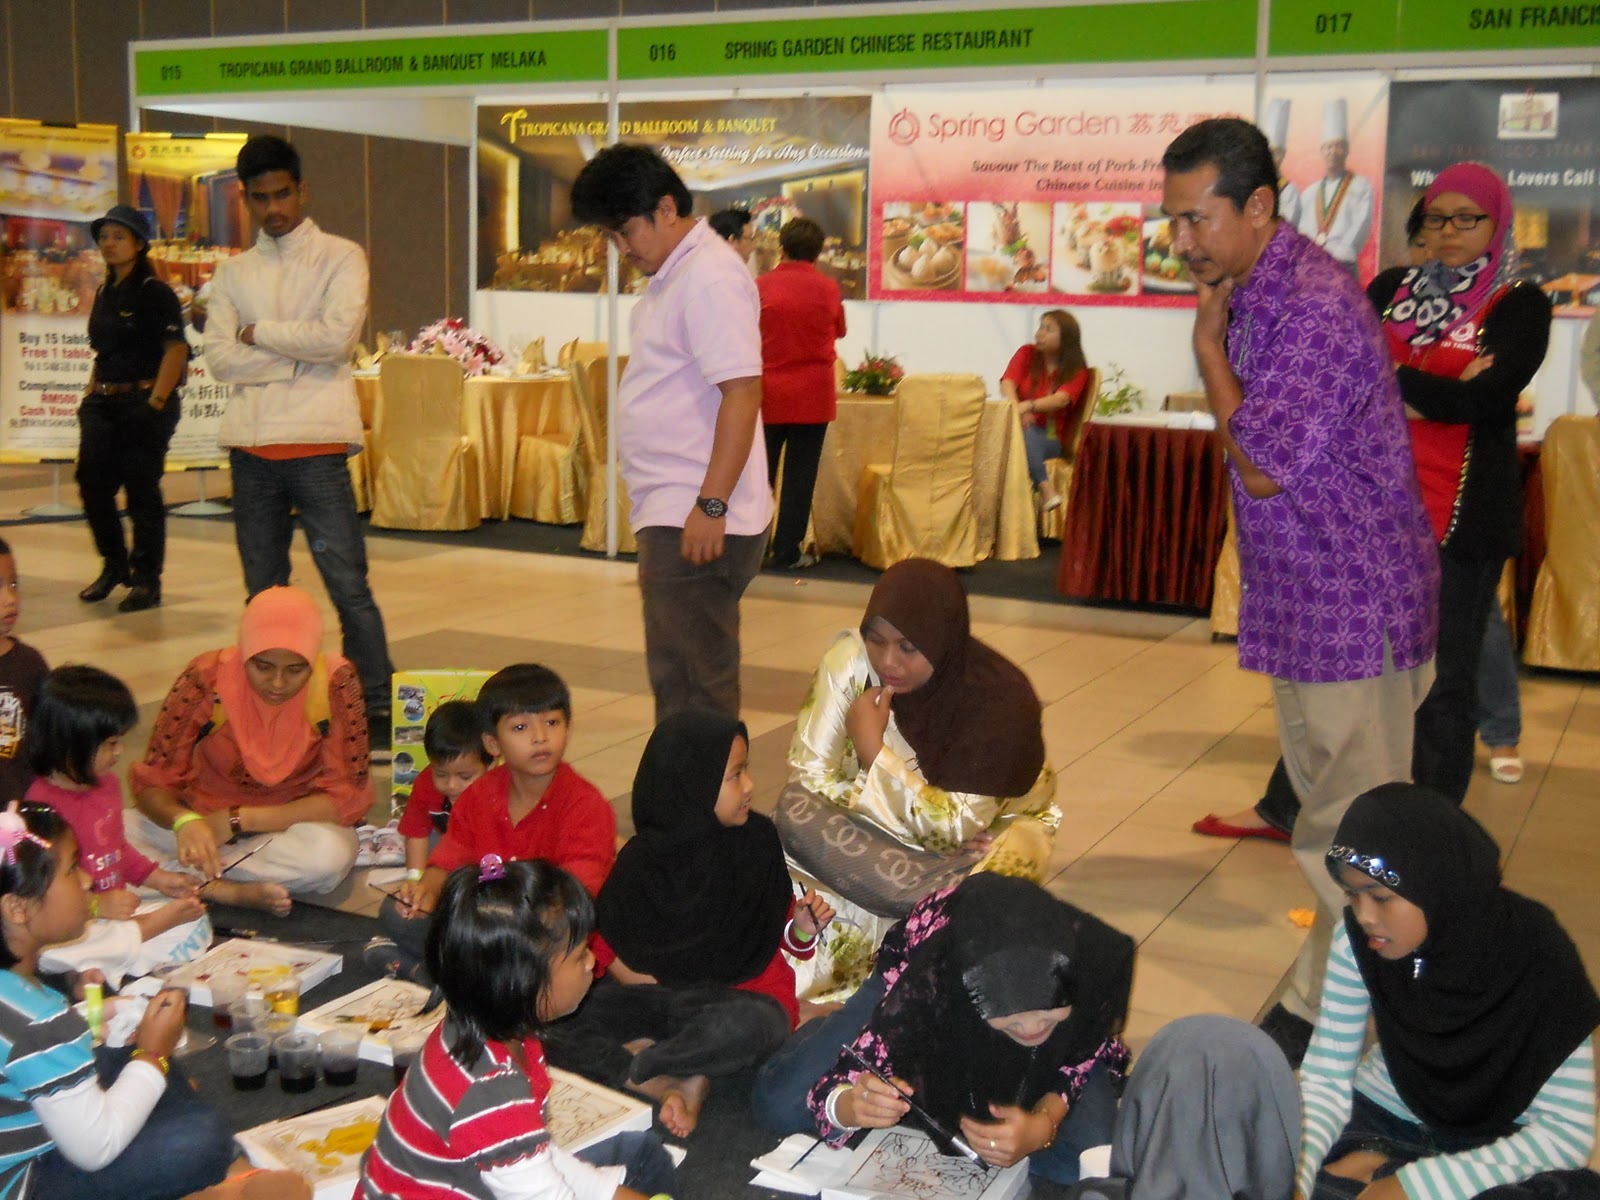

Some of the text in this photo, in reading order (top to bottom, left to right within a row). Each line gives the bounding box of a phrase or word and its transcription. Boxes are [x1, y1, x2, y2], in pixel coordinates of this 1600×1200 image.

[1316, 12, 1352, 34] 017
[1469, 8, 1512, 30] SAN
[650, 43, 676, 61] 016
[724, 28, 1034, 60] SPRING GARDEN CHINESE RESTAURANT
[161, 65, 181, 81] 015
[219, 50, 547, 79] TROPICANA GRAND BALLROOM & BANQUET MELAKA
[520, 121, 586, 136] TROPICANA
[633, 119, 699, 135] BALLROOM
[702, 117, 714, 134] &
[717, 116, 777, 135] BANQUET
[928, 109, 1120, 143] Spring Garden
[704, 144, 750, 164] Setting
[751, 144, 773, 164] for
[774, 143, 805, 163] Any
[808, 142, 866, 160] Occasion
[971, 160, 1020, 172] Savour
[1024, 159, 1048, 172] The
[1053, 159, 1084, 172] Best
[1087, 160, 1102, 175] of
[1036, 178, 1090, 192] Chinese
[1094, 178, 1144, 192] Cuisine
[1508, 169, 1560, 187] Lovers
[1563, 168, 1595, 187] Call
[19, 332, 40, 346] Buy
[45, 332, 58, 344] 15
[22, 346, 48, 358] Free
[62, 348, 92, 359] table
[20, 405, 45, 416] Cash
